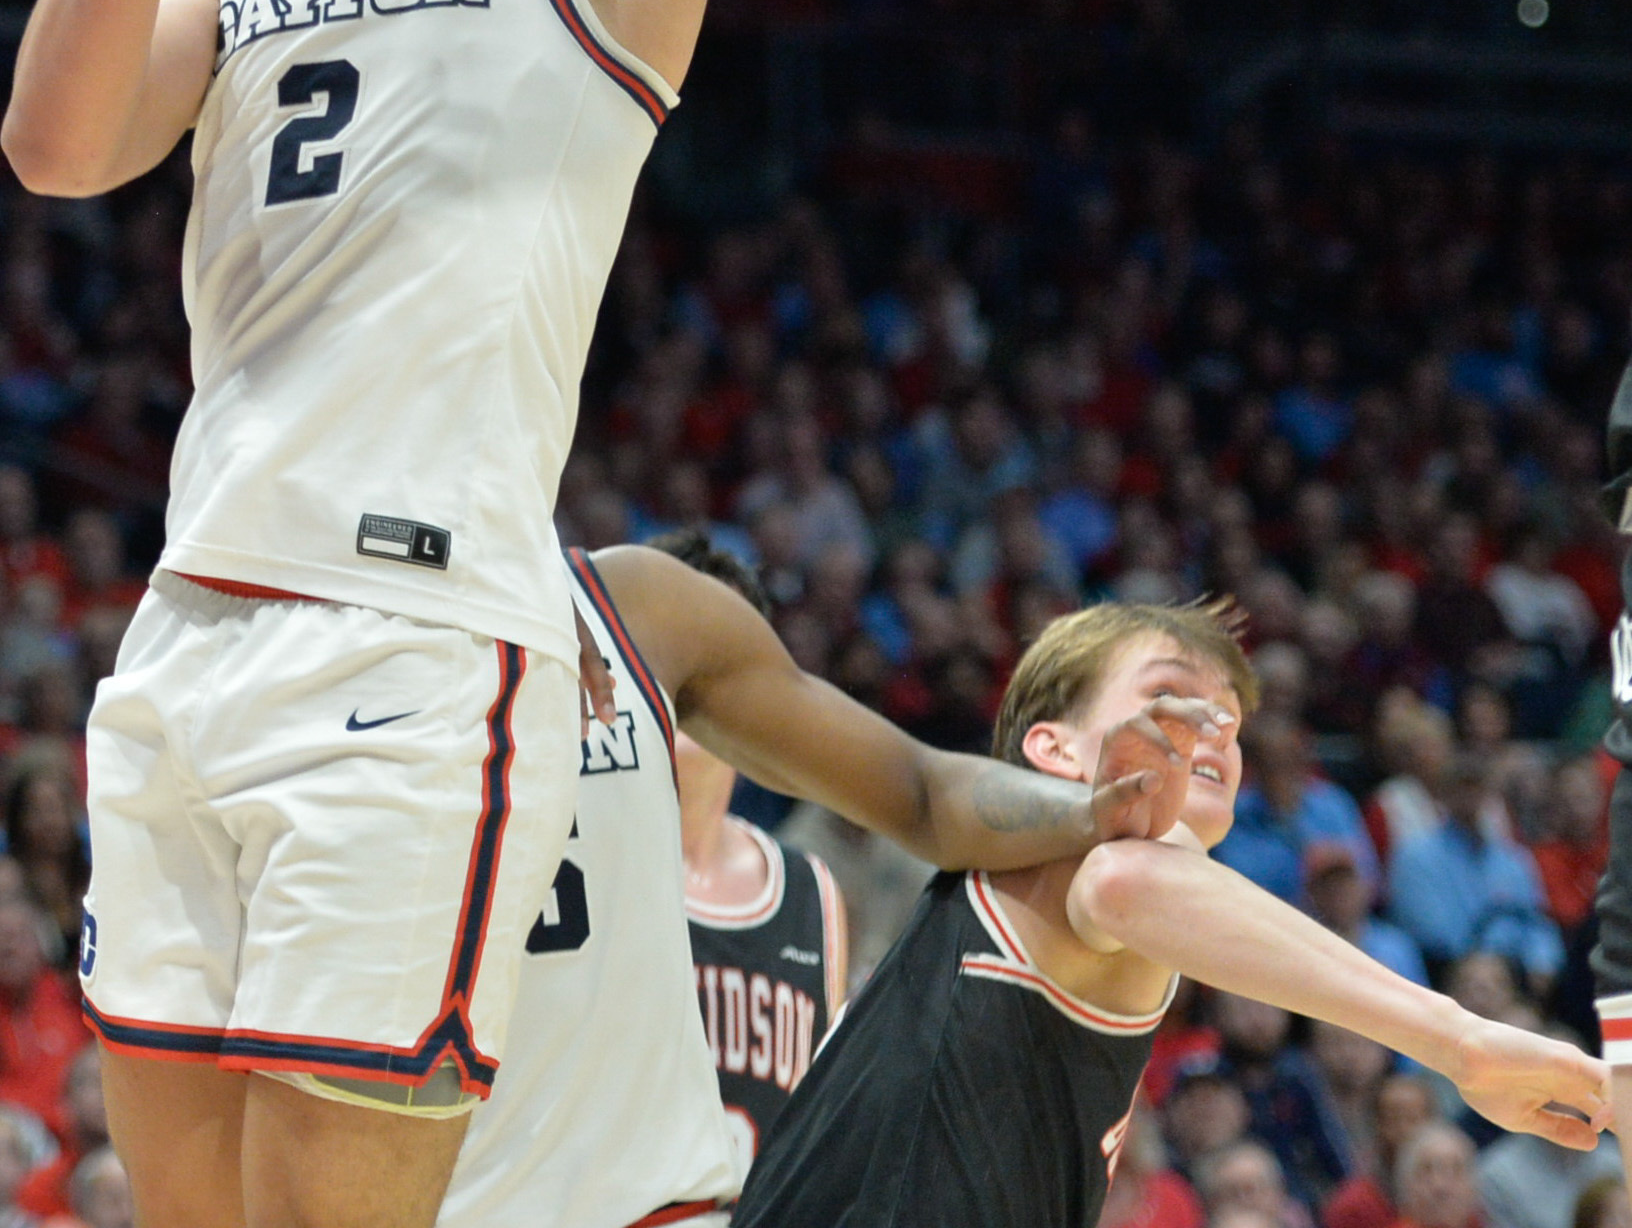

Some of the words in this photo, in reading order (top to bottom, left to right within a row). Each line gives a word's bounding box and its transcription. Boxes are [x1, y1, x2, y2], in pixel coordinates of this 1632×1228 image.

[264, 58, 361, 208] 2
[422, 535, 436, 556] L
[694, 962, 815, 1094] IDSON
